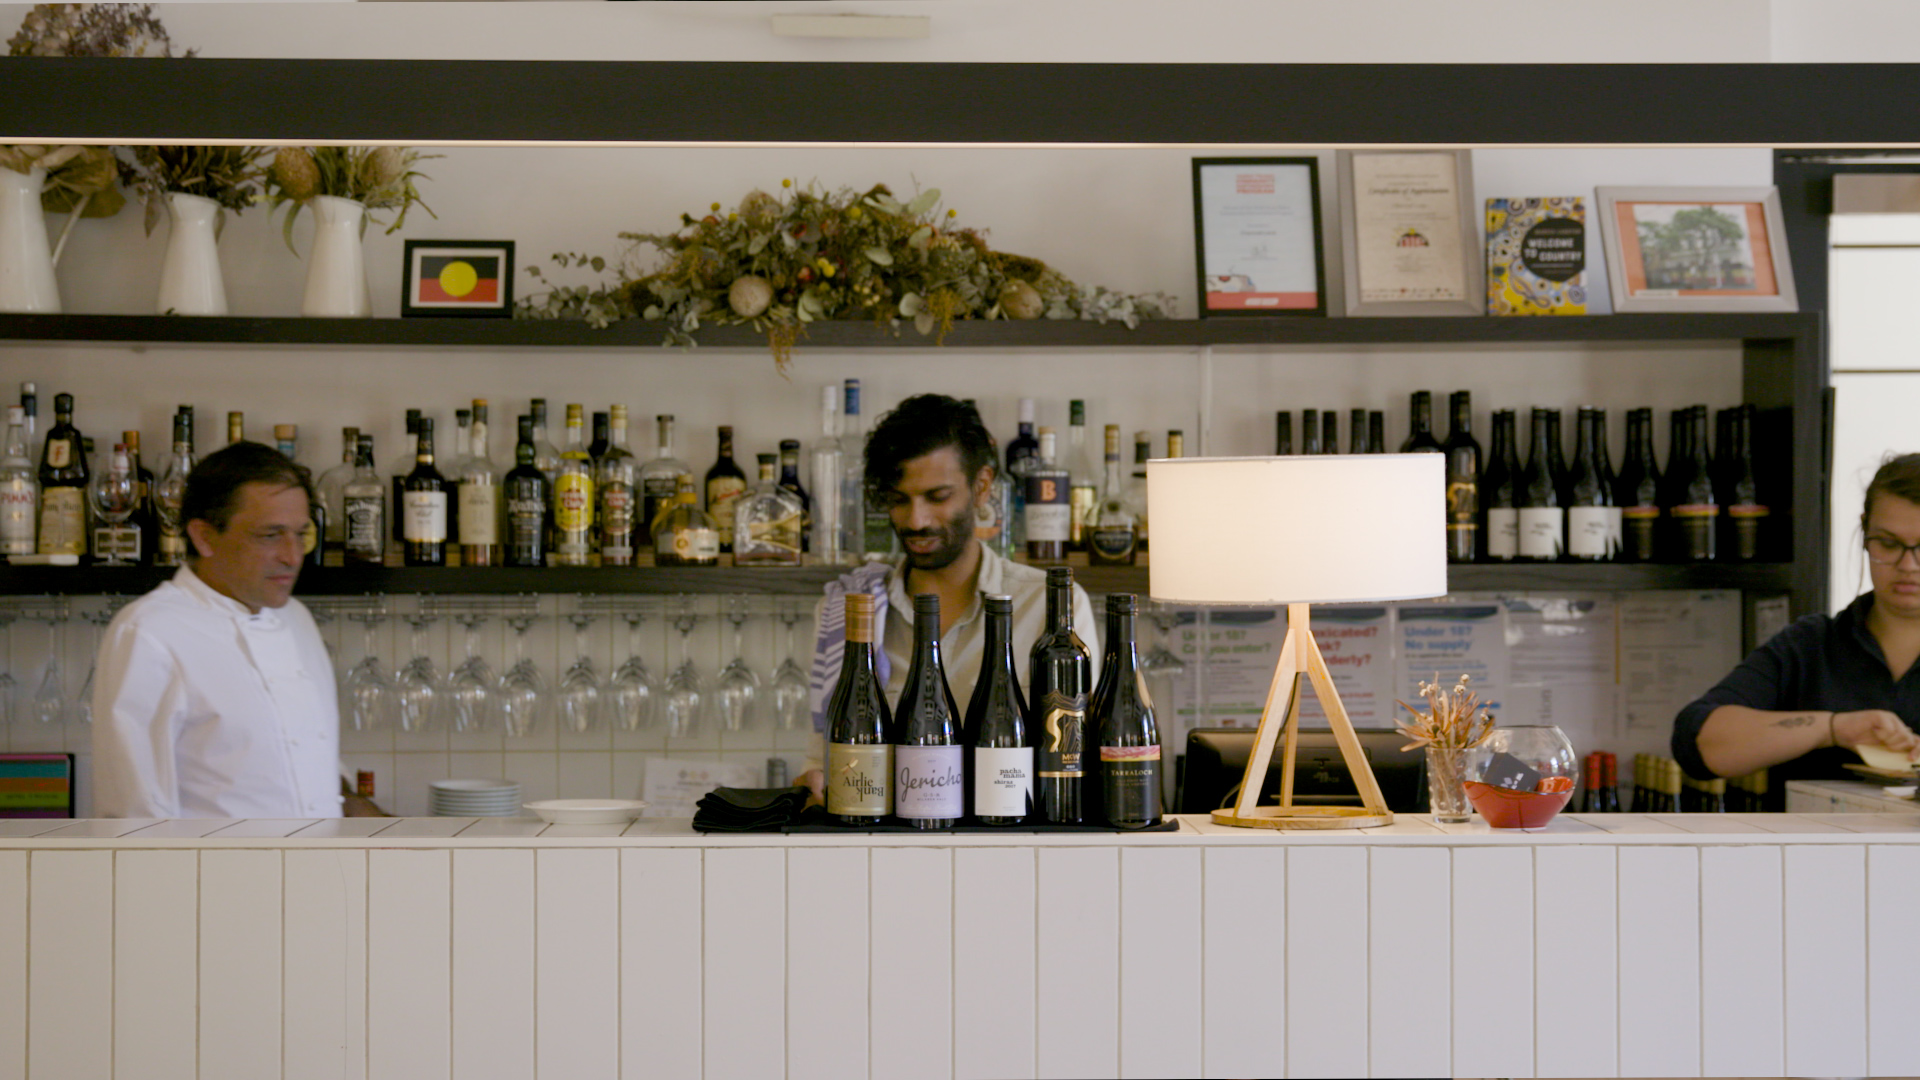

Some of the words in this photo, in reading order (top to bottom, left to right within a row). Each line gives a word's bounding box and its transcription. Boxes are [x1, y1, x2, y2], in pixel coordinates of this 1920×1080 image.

[1527, 237, 1574, 249] WELCOME
[1524, 248, 1538, 258] TO
[1539, 251, 1582, 262] COUNTRY
[1040, 480, 1057, 501] B
[1226, 630, 1247, 640] 18?
[1312, 626, 1378, 638] oxicated?
[1404, 626, 1445, 637] Under
[1450, 625, 1473, 636] 18?
[1405, 640, 1424, 650] No
[1428, 640, 1472, 652] supply
[1000, 767, 1022, 775] pacha
[843, 771, 874, 787] Airlie
[900, 765, 962, 803] Jericho
[856, 786, 884, 802] Bank
